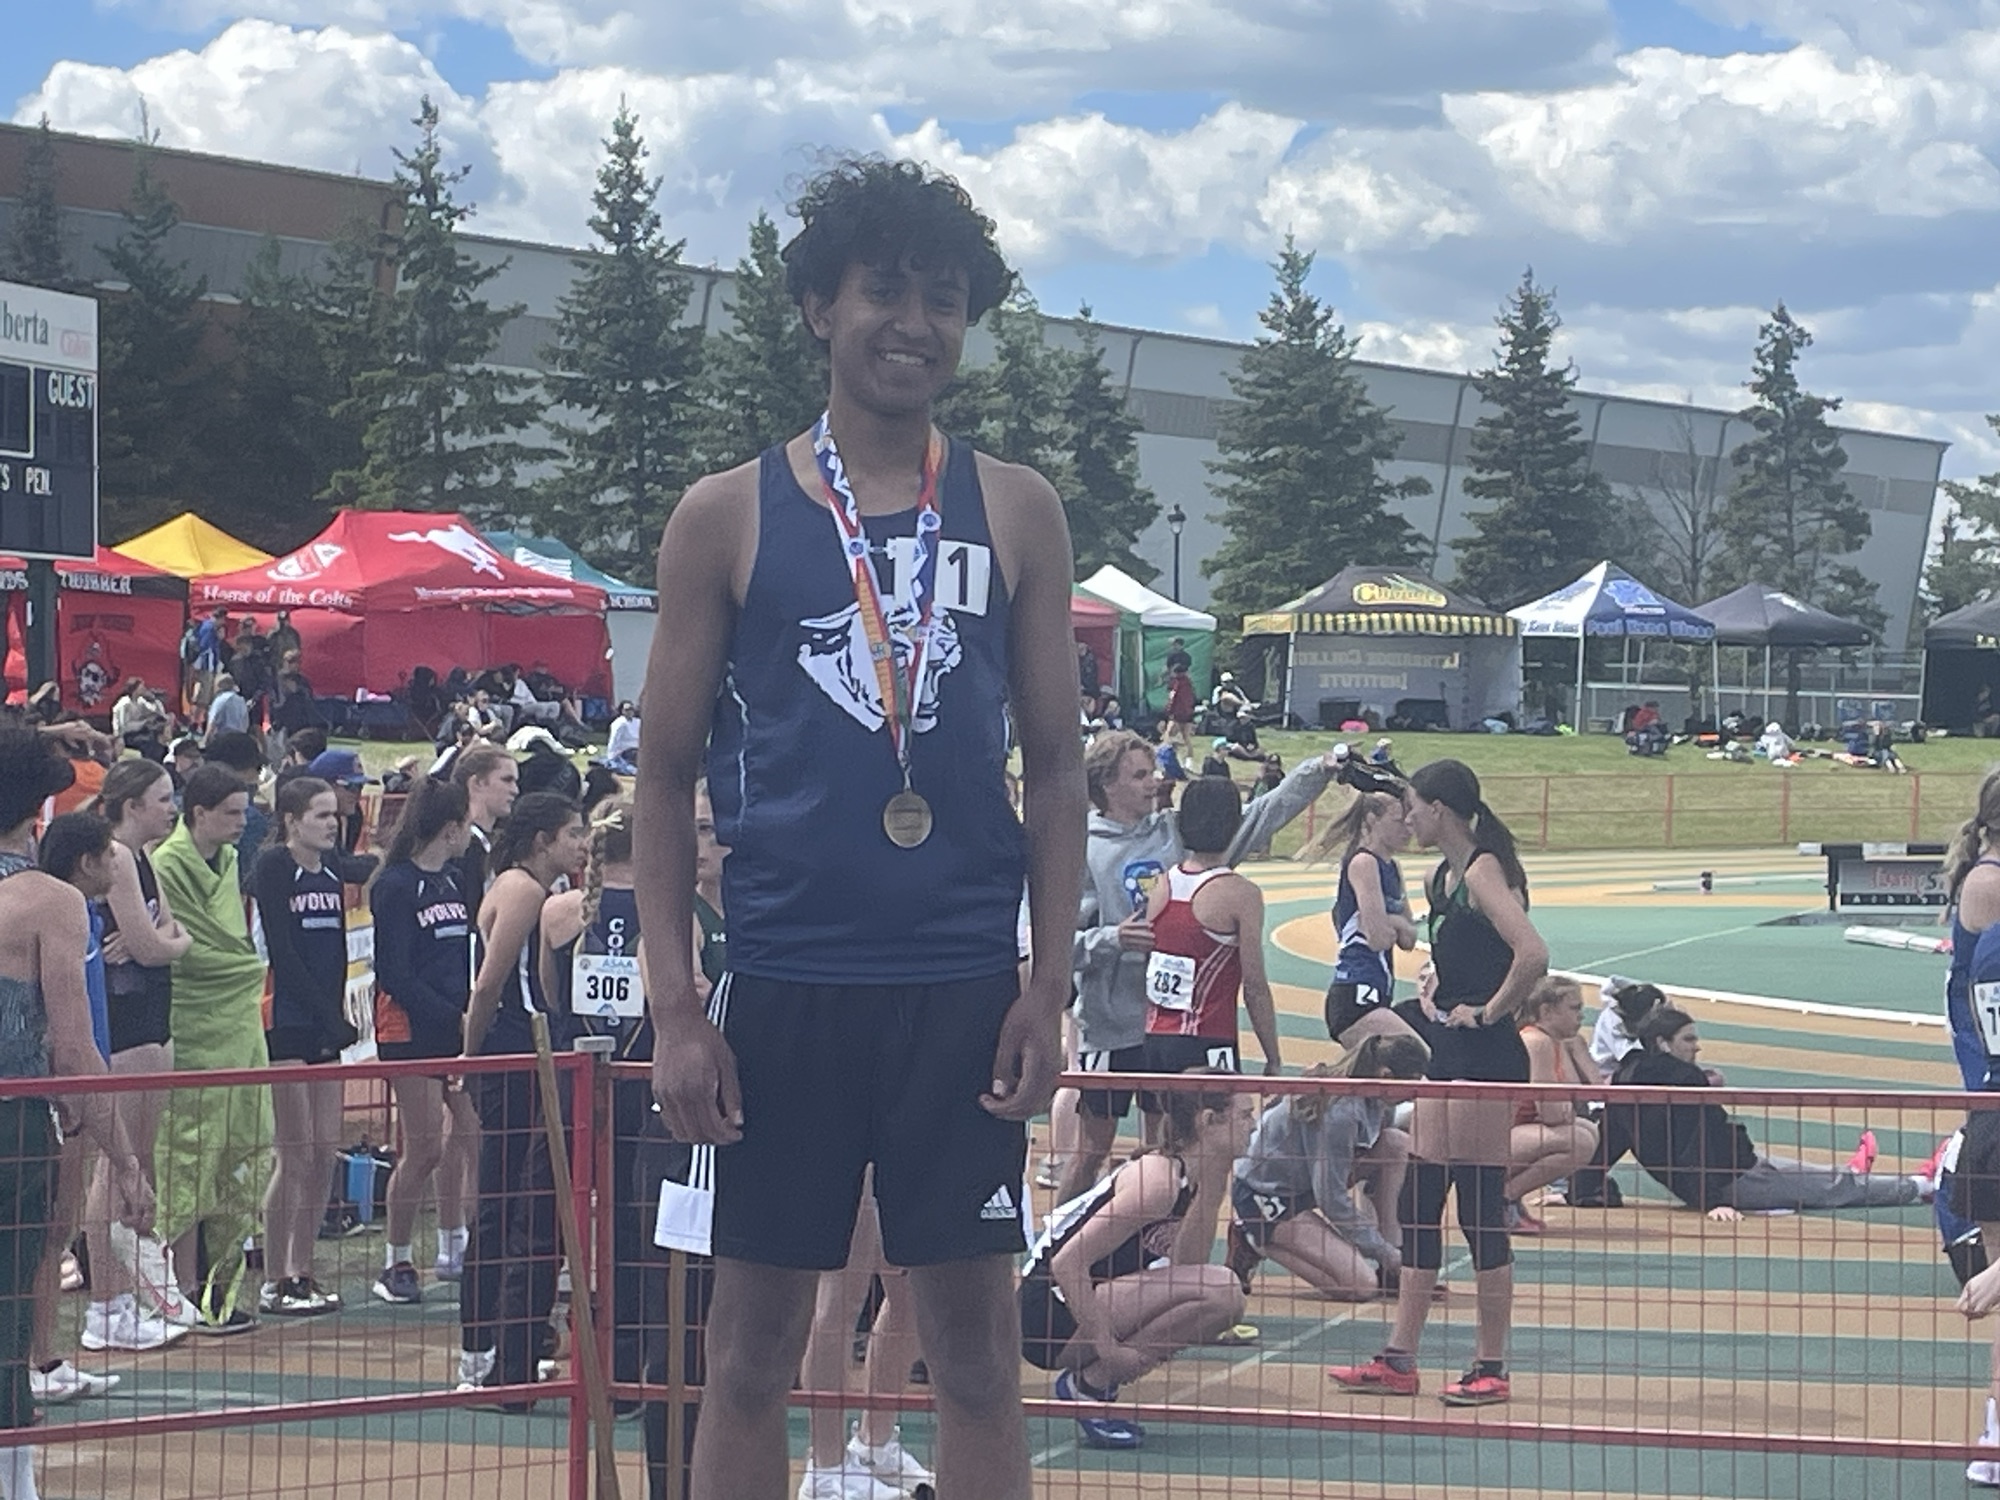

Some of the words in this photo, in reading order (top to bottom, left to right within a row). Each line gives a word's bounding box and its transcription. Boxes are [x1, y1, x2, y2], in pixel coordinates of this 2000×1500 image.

[0, 300, 49, 346] berta
[48, 371, 95, 410] GUEST
[947, 546, 968, 606] 1
[203, 585, 252, 602] Home
[256, 586, 276, 603] of
[280, 586, 304, 604] the
[586, 975, 630, 1001] 306
[1154, 970, 1182, 995] 282
